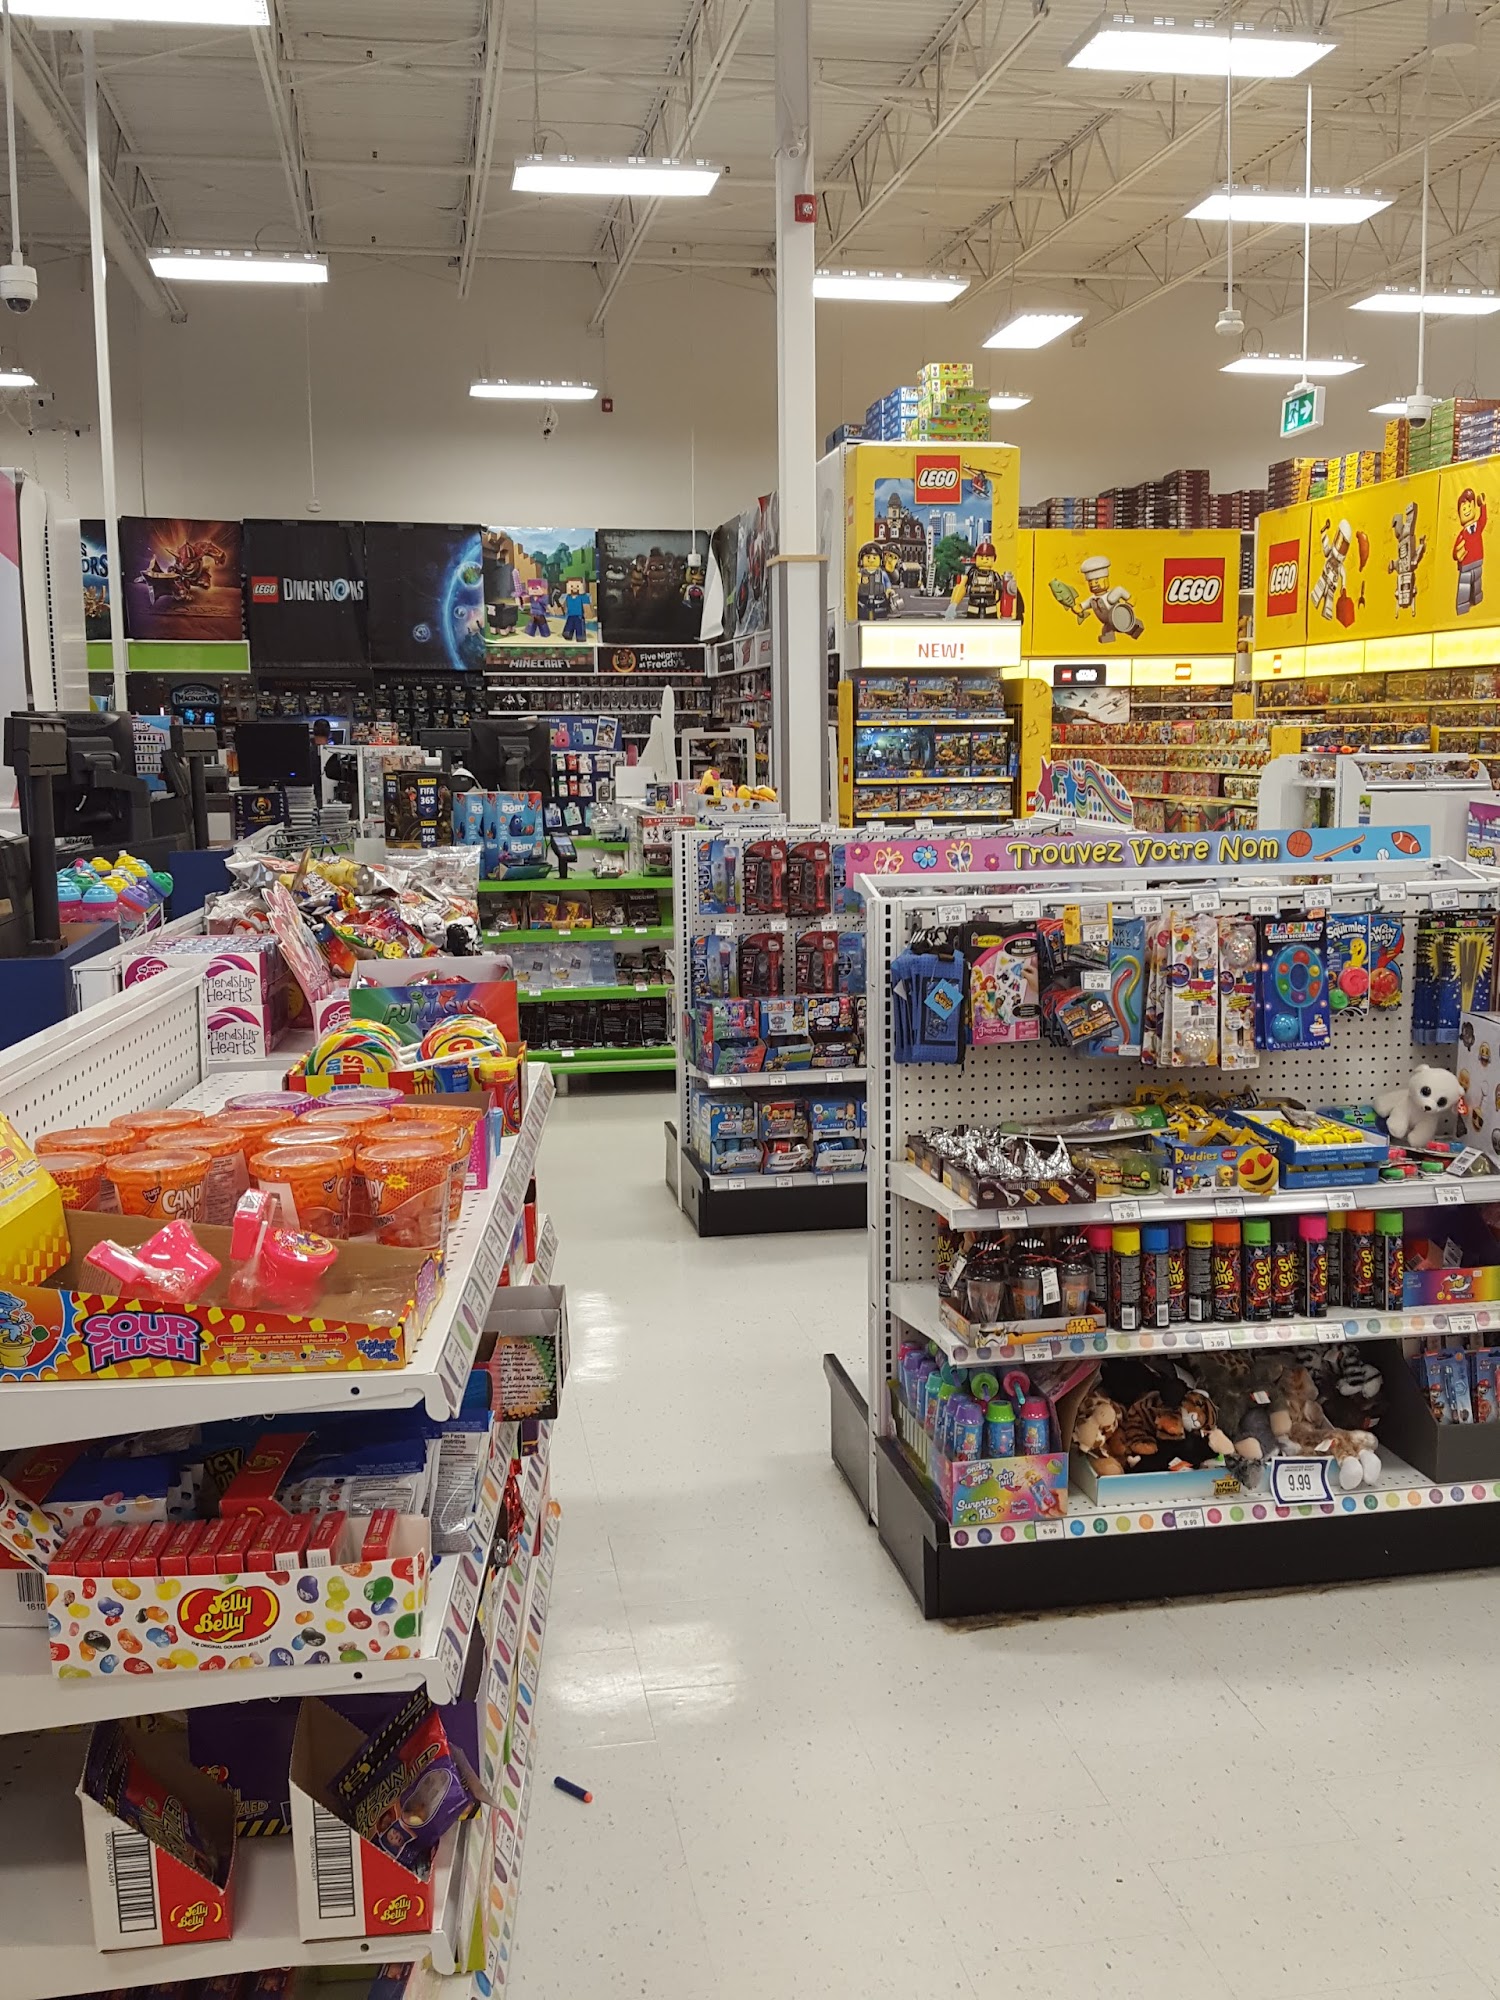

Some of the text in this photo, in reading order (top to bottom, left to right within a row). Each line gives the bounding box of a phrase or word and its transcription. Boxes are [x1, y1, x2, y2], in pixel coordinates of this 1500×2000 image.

[919, 469, 958, 487] LEGO
[1269, 563, 1297, 594] LEGO
[254, 577, 364, 602] LEGO DIMENSIONS
[1167, 577, 1221, 603] LEGO
[640, 653, 656, 661] Five
[918, 643, 965, 660] NEW!
[509, 659, 572, 669] MINECRAFT
[420, 796, 435, 804] 365
[502, 804, 525, 813] DORY
[511, 843, 533, 851] DORY
[1008, 835, 1279, 869] Trouvez Votre Nom
[1020, 909, 1034, 917] 2.99
[1113, 930, 1131, 938] NKY
[1265, 922, 1323, 936] FLASHING
[1113, 939, 1131, 947] NKS
[206, 989, 252, 1002] Hearts
[210, 1041, 256, 1055] Hearts
[1175, 1148, 1217, 1164] Buddiez
[162, 1184, 201, 1214] CAND
[85, 1313, 199, 1344] SOUR
[1069, 1318, 1097, 1326] STAR
[1067, 1325, 1097, 1334] WARS
[92, 1337, 196, 1368] FLUSH
[1288, 1474, 1312, 1491] 9.99
[208, 1591, 252, 1616] Jelly
[194, 1611, 244, 1634] Belly
[236, 1800, 269, 1816] ZLED
[185, 1904, 208, 1918] Jelly
[389, 1898, 411, 1912] Jelly
[177, 1916, 204, 1928] Belly
[380, 1909, 408, 1922] Belly
